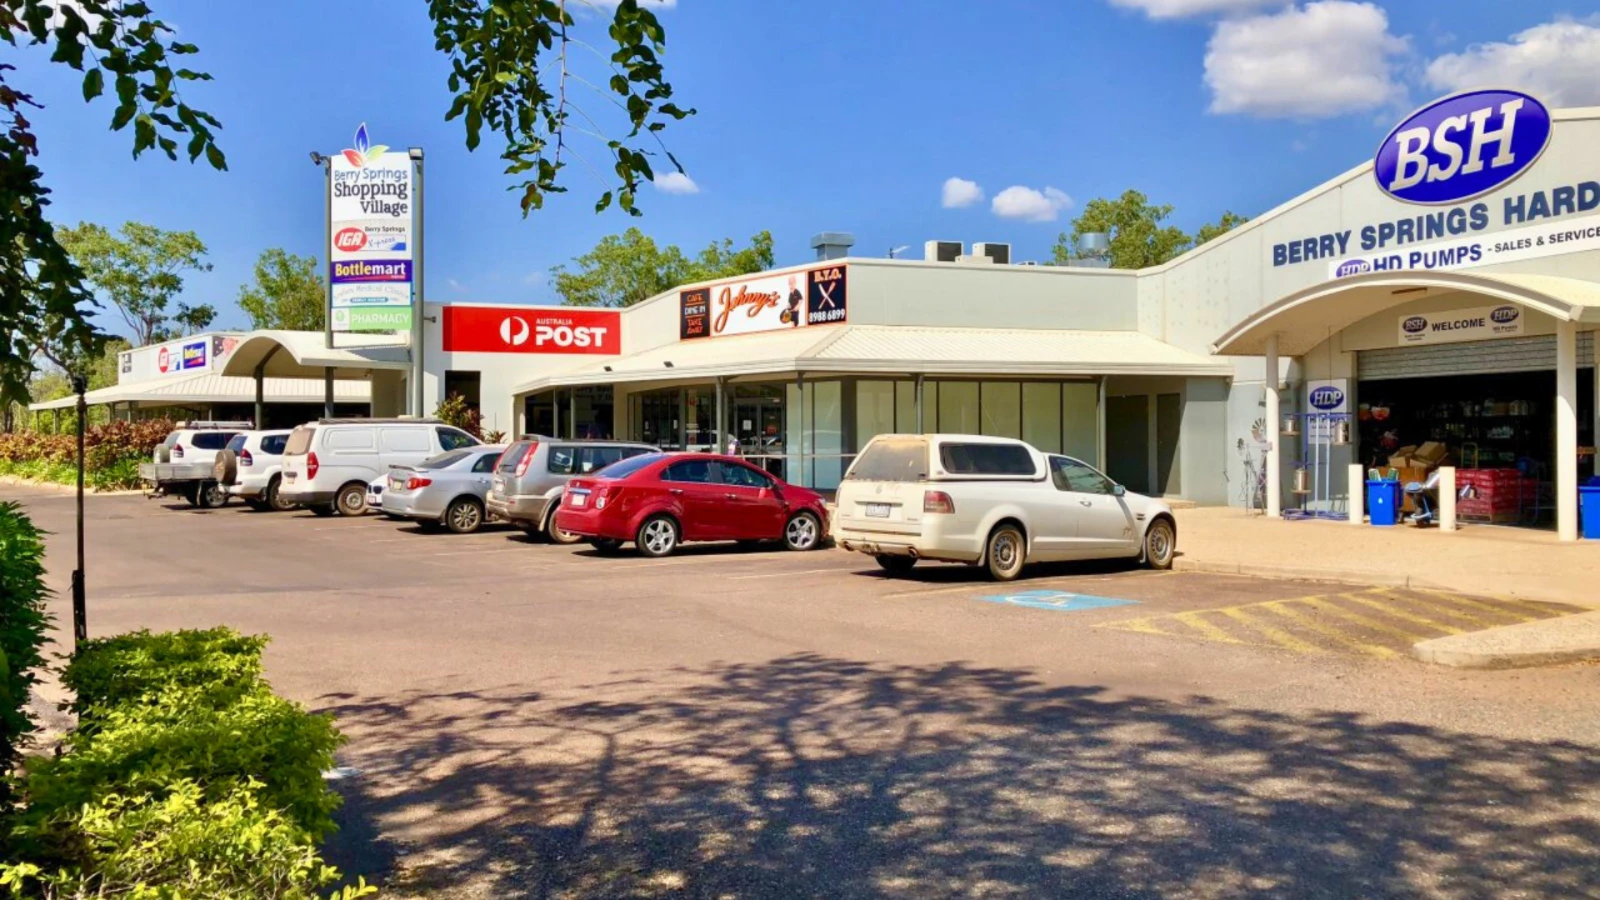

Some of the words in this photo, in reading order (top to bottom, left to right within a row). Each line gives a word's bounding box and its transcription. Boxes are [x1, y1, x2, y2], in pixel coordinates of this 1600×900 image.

[1389, 97, 1524, 192] BSH
[334, 169, 360, 183] Berry
[362, 167, 408, 182] Springs
[334, 180, 408, 200] Shopping
[360, 200, 408, 217] Village
[1273, 230, 1352, 266] BERRY
[1360, 203, 1489, 250] SPRINGS
[1503, 180, 1600, 225] HARD
[337, 231, 364, 247] IGA
[1409, 243, 1482, 269] PUMPS
[1494, 238, 1532, 253] SALES
[1536, 235, 1545, 246] &
[335, 261, 406, 277] Bottlemart
[352, 313, 409, 324] PHARMACY
[1494, 309, 1518, 320] HDP
[1405, 319, 1425, 330] BSH
[1431, 318, 1486, 332] WELCOME
[535, 326, 607, 347] POST
[1313, 390, 1342, 405] HDP
